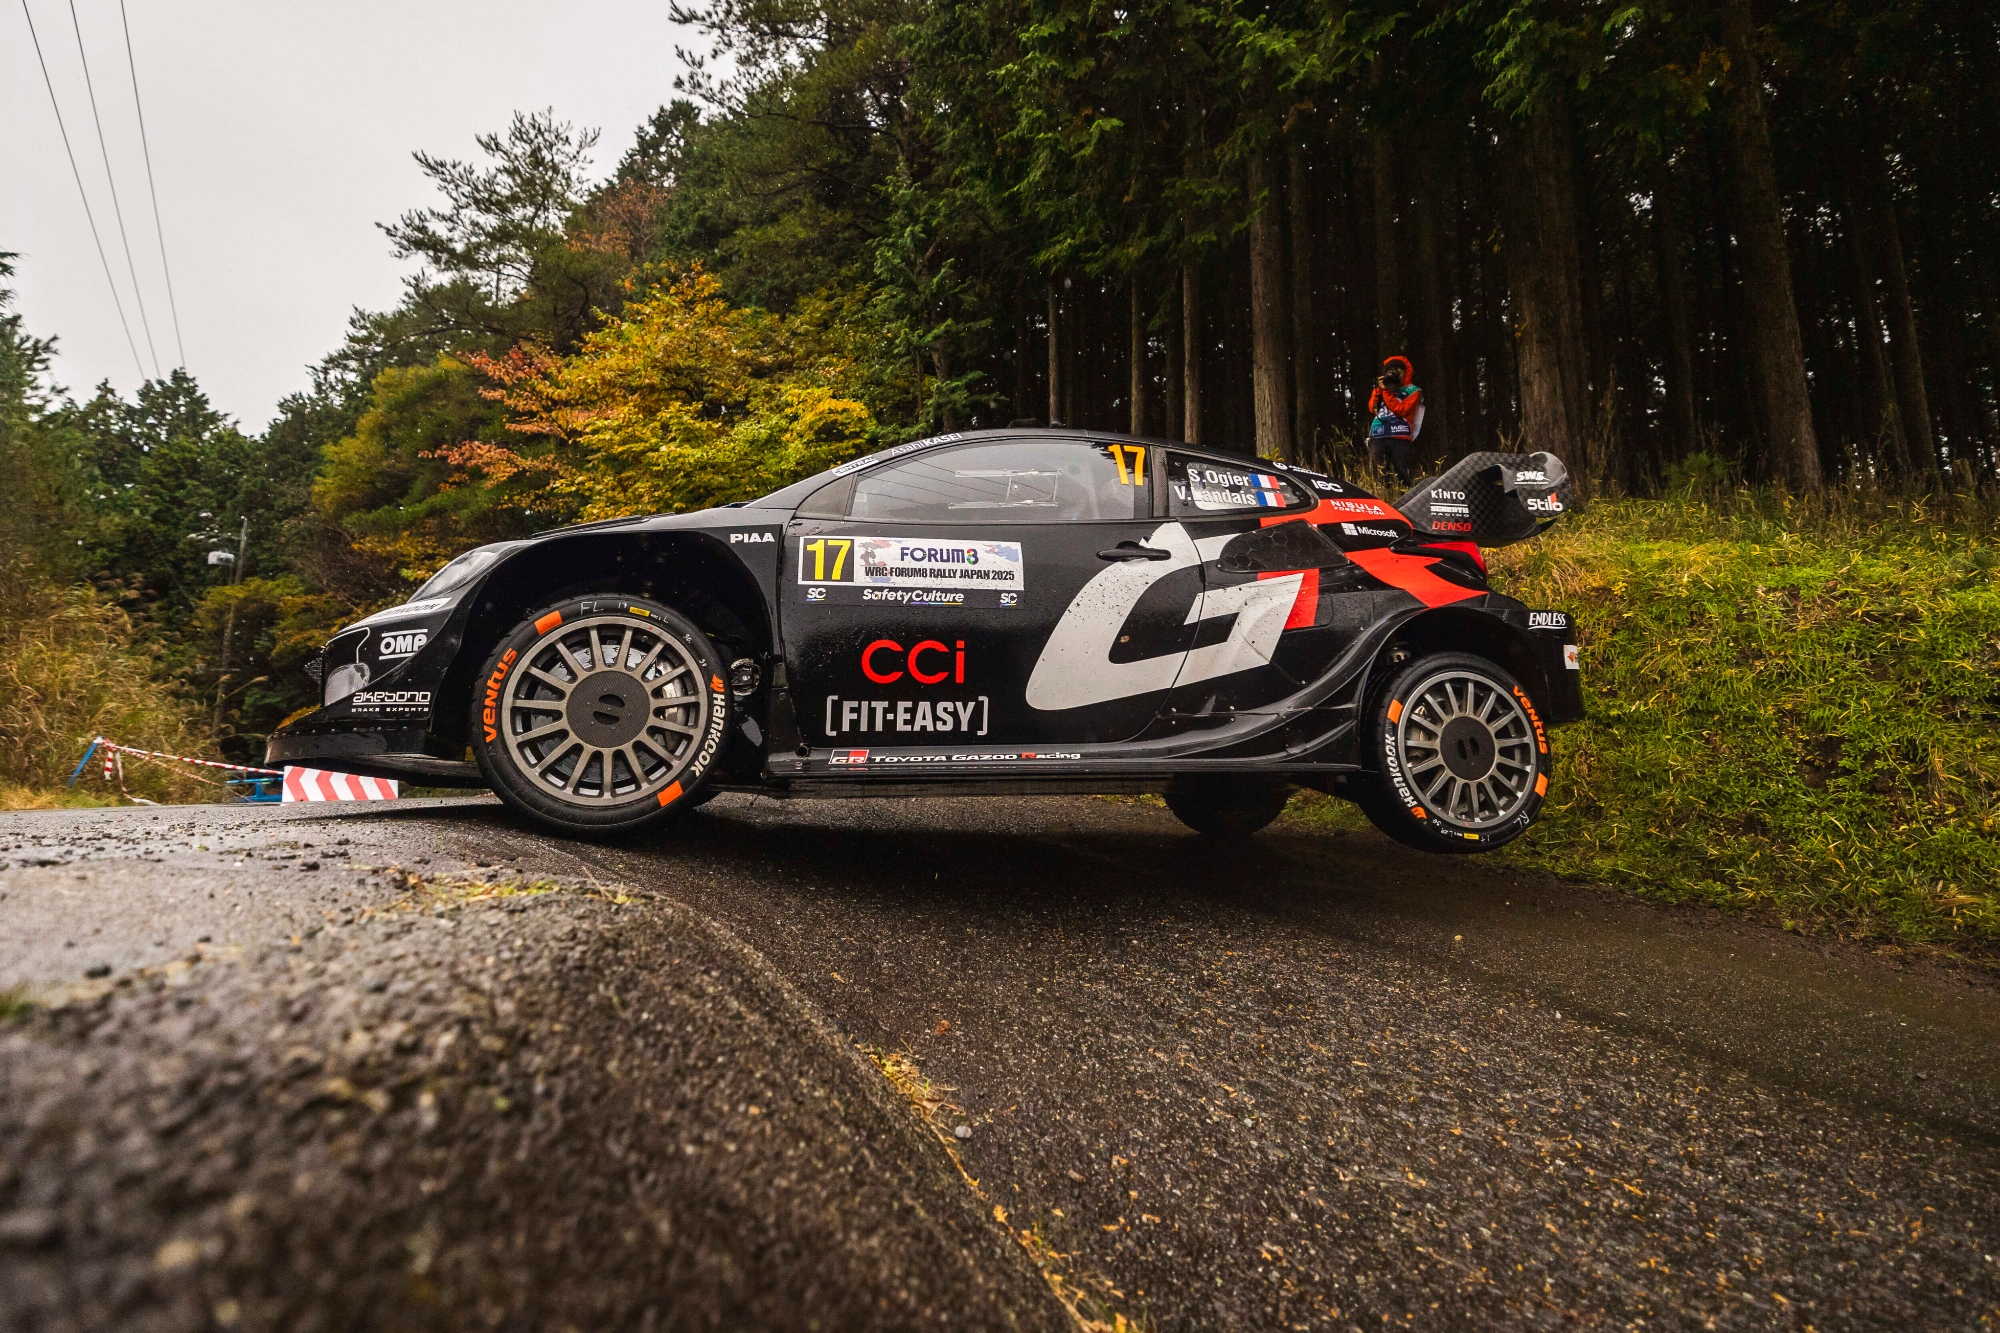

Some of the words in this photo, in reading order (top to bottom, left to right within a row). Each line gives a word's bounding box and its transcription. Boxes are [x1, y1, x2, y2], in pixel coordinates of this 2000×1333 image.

[1108, 444, 1146, 486] 17
[1330, 499, 1383, 513] NISULA
[1527, 492, 1563, 512] Stilo
[1356, 525, 1399, 539] Microsoft
[1431, 520, 1473, 532] DENSO
[729, 532, 775, 544] PIAA
[806, 539, 851, 581] 17
[900, 546, 979, 565] FORUM8
[864, 566, 888, 577] WRC
[889, 566, 928, 578] FORUM8
[929, 568, 958, 579] RALLY
[959, 569, 991, 580] JAPAN
[991, 570, 1015, 581] 2025
[807, 587, 826, 599] SC
[1000, 592, 1018, 604] SC
[1528, 612, 1566, 626] ENDLESS
[380, 633, 428, 655] OMP
[871, 755, 947, 763] TOYOTA
[951, 754, 1017, 762] GAZOO
